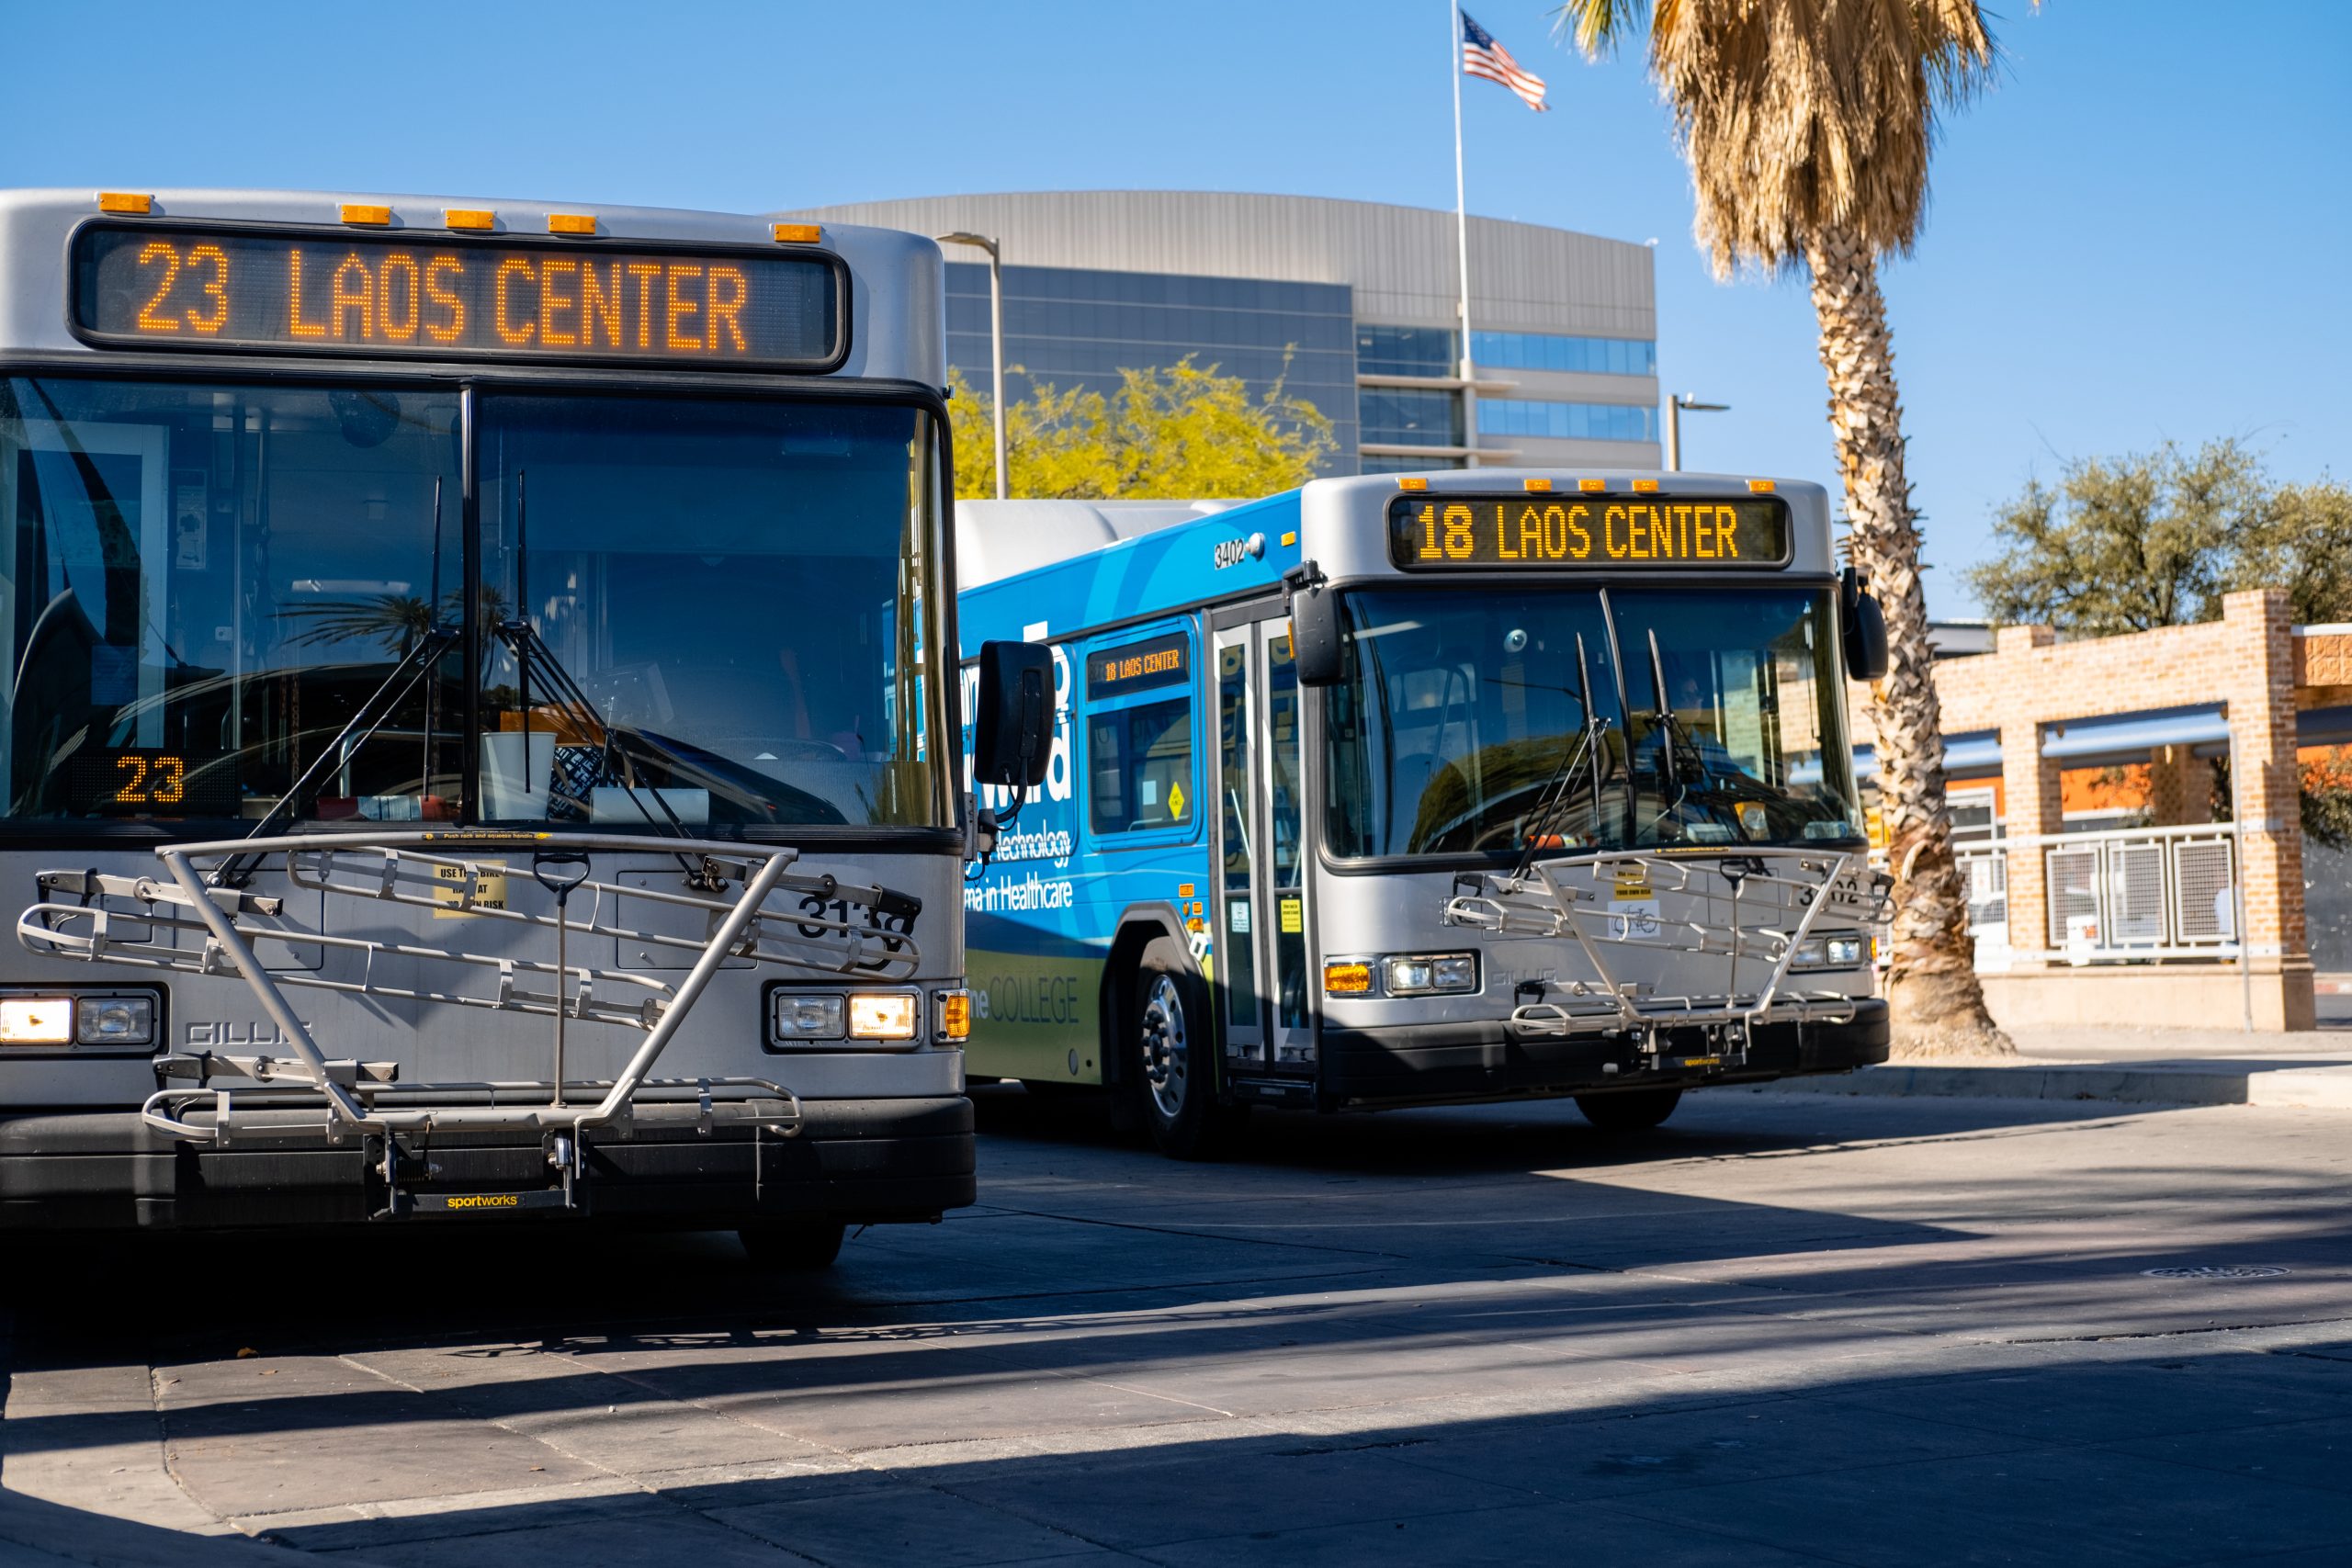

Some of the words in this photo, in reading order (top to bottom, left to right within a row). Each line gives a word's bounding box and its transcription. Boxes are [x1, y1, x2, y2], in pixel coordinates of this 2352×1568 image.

[139, 242, 228, 332] 23
[290, 249, 465, 341] LAOS
[496, 258, 746, 351] CENTER
[1419, 505, 1474, 558] 18
[1497, 505, 1590, 558] LAOS
[1605, 505, 1738, 558] CENTER
[1216, 538, 1245, 569] 3402
[1105, 662, 1116, 682] 18
[1119, 657, 1142, 679] LAOS
[1144, 649, 1180, 674] CENTER
[117, 756, 183, 802] 23
[440, 868, 457, 878] USE
[478, 884, 488, 894] AT
[986, 877, 998, 911] in
[1001, 871, 1073, 910] Healthcare
[1799, 879, 1858, 907] 302
[484, 900, 504, 910] RISK
[447, 1195, 518, 1209] sportworks
